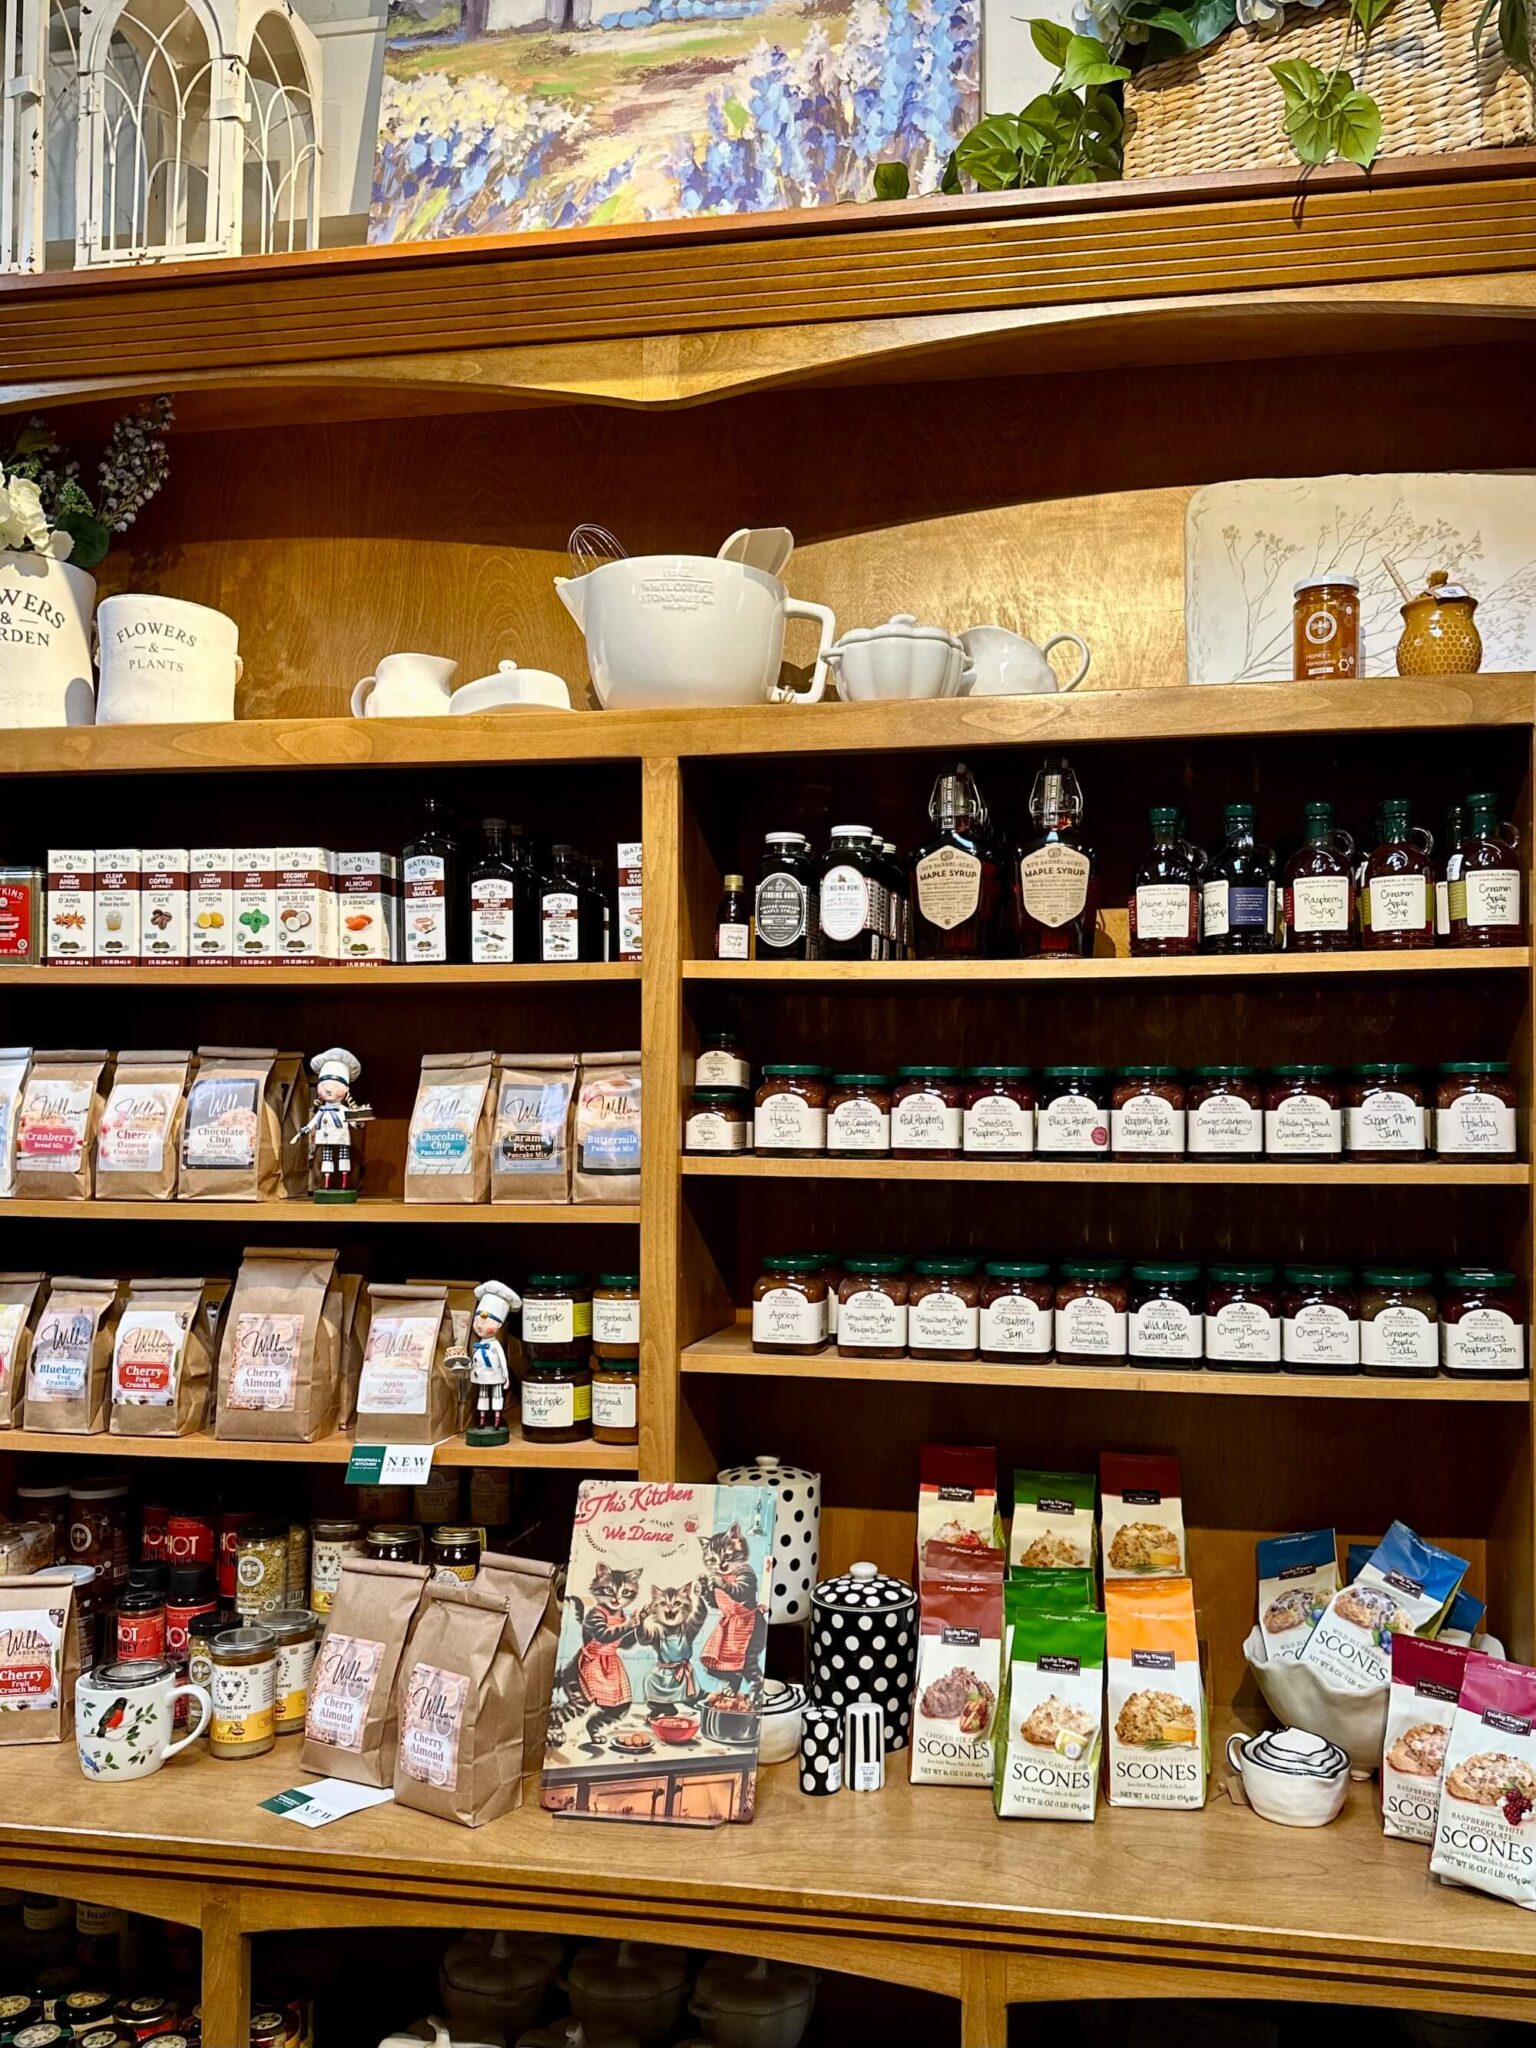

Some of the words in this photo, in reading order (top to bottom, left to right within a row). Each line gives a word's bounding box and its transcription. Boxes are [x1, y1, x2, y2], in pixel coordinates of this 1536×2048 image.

[0, 612, 12, 624] &
[116, 622, 198, 648] FLOWERS
[149, 642, 158, 652] &
[1306, 652, 1325, 660] Honey
[129, 659, 184, 673] PLANTS
[52, 855, 88, 865] WATKINS
[99, 853, 131, 864] WATKINS
[146, 854, 178, 864] WATKINS
[194, 854, 227, 863] WATKINS
[237, 853, 271, 863] WATKINS
[280, 852, 313, 861] WATKINS
[342, 856, 375, 866] WATKINS
[406, 858, 441, 870] WATKINS
[920, 870, 947, 880] MAPLE
[949, 869, 977, 878] SYRUP
[1025, 868, 1053, 878] MAPLE
[1057, 867, 1085, 877] SYRUP
[477, 883, 508, 892] WATKINS
[1479, 884, 1511, 893] Cinnamon
[1381, 889, 1414, 899] Cinnamon
[1387, 907, 1408, 919] Syrup
[1486, 903, 1507, 914] Syrup
[1152, 909, 1174, 920] Syrup
[586, 1094, 639, 1120] Willow
[978, 1118, 1014, 1127] Seedless
[1278, 1118, 1304, 1130] Holiday
[1304, 1119, 1330, 1128] Spiced
[1363, 1115, 1388, 1130] Sugar
[1395, 1115, 1416, 1125] Plum
[27, 1132, 75, 1143] Cranberry
[198, 1128, 244, 1136] Chocolate
[420, 1133, 464, 1142] Chocolate
[909, 1128, 930, 1138] Jam
[968, 1128, 1004, 1142] Raspberry
[1062, 1128, 1081, 1138] Jam
[1276, 1130, 1310, 1142] Cranberry
[1378, 1127, 1403, 1139] Jam
[209, 1135, 231, 1145] Chip
[508, 1134, 549, 1143] Caramel
[587, 1135, 638, 1146] Buttermilk
[431, 1141, 451, 1151] Chip
[513, 1143, 542, 1151] Pecan
[769, 1312, 802, 1323] Apricot
[844, 1313, 879, 1324] Strawberry
[916, 1315, 951, 1326] Strawberry
[773, 1323, 794, 1332] Jam
[849, 1323, 875, 1334] Rhubarb
[877, 1325, 892, 1334] Jam
[993, 1315, 1035, 1334] Strawberry
[41, 1319, 89, 1351] Willow
[920, 1326, 948, 1336] Rhubarb
[949, 1327, 965, 1336] Jam
[1003, 1329, 1023, 1339] Jam
[1218, 1324, 1245, 1338] Cherry
[1246, 1325, 1270, 1341] Berry
[1296, 1326, 1324, 1342] Cherry
[1325, 1328, 1349, 1343] Berry
[1383, 1327, 1420, 1338] Cinnamon
[123, 1327, 175, 1353] Willow
[1169, 1333, 1189, 1341] Jam
[1466, 1332, 1506, 1343] Seedless
[241, 1330, 294, 1358] Willow
[1235, 1339, 1253, 1350] Jam
[1313, 1342, 1332, 1352] Jam
[1387, 1347, 1418, 1357] Jelly
[1454, 1342, 1497, 1359] Raspberry
[1498, 1344, 1516, 1353] Jam
[39, 1365, 81, 1376] Blueberry
[125, 1366, 163, 1378] Cherry
[246, 1367, 280, 1380] Cherry
[242, 1379, 281, 1388] Almond
[383, 1380, 404, 1389] Apple
[386, 1456, 429, 1466] NEW
[629, 1483, 693, 1511] Kitchen
[602, 1526, 626, 1540] We
[627, 1526, 673, 1542] Dance
[165, 1535, 199, 1555] HOT
[1315, 1630, 1389, 1681] SCONES
[324, 1654, 370, 1685] Willow
[0, 1670, 44, 1682] Cherry
[0, 1686, 27, 1694] Crunch
[324, 1696, 354, 1713] Cherry
[412, 1686, 456, 1720] Willow
[318, 1706, 354, 1724] Almond
[413, 1732, 444, 1749] Cherry
[410, 1743, 444, 1762] Almond
[918, 1737, 990, 1760] SCONES
[1012, 1762, 1090, 1789] SCONES
[1116, 1762, 1197, 1781] SCONES
[1120, 1790, 1132, 1799] NET
[1132, 1791, 1143, 1800] WT
[1144, 1792, 1150, 1800] 16
[1151, 1792, 1160, 1801] OZ
[1397, 1784, 1436, 1798] RASPBERRY
[1452, 1812, 1496, 1831] RASPBERRY
[1498, 1822, 1525, 1837] WHITE
[1461, 1823, 1514, 1841] CHOCOLATE
[1440, 1825, 1533, 1865] SCONES
[1442, 1854, 1455, 1865] NET
[1456, 1858, 1468, 1869] WT
[1469, 1862, 1476, 1871] 16
[1476, 1865, 1488, 1875] OZ
